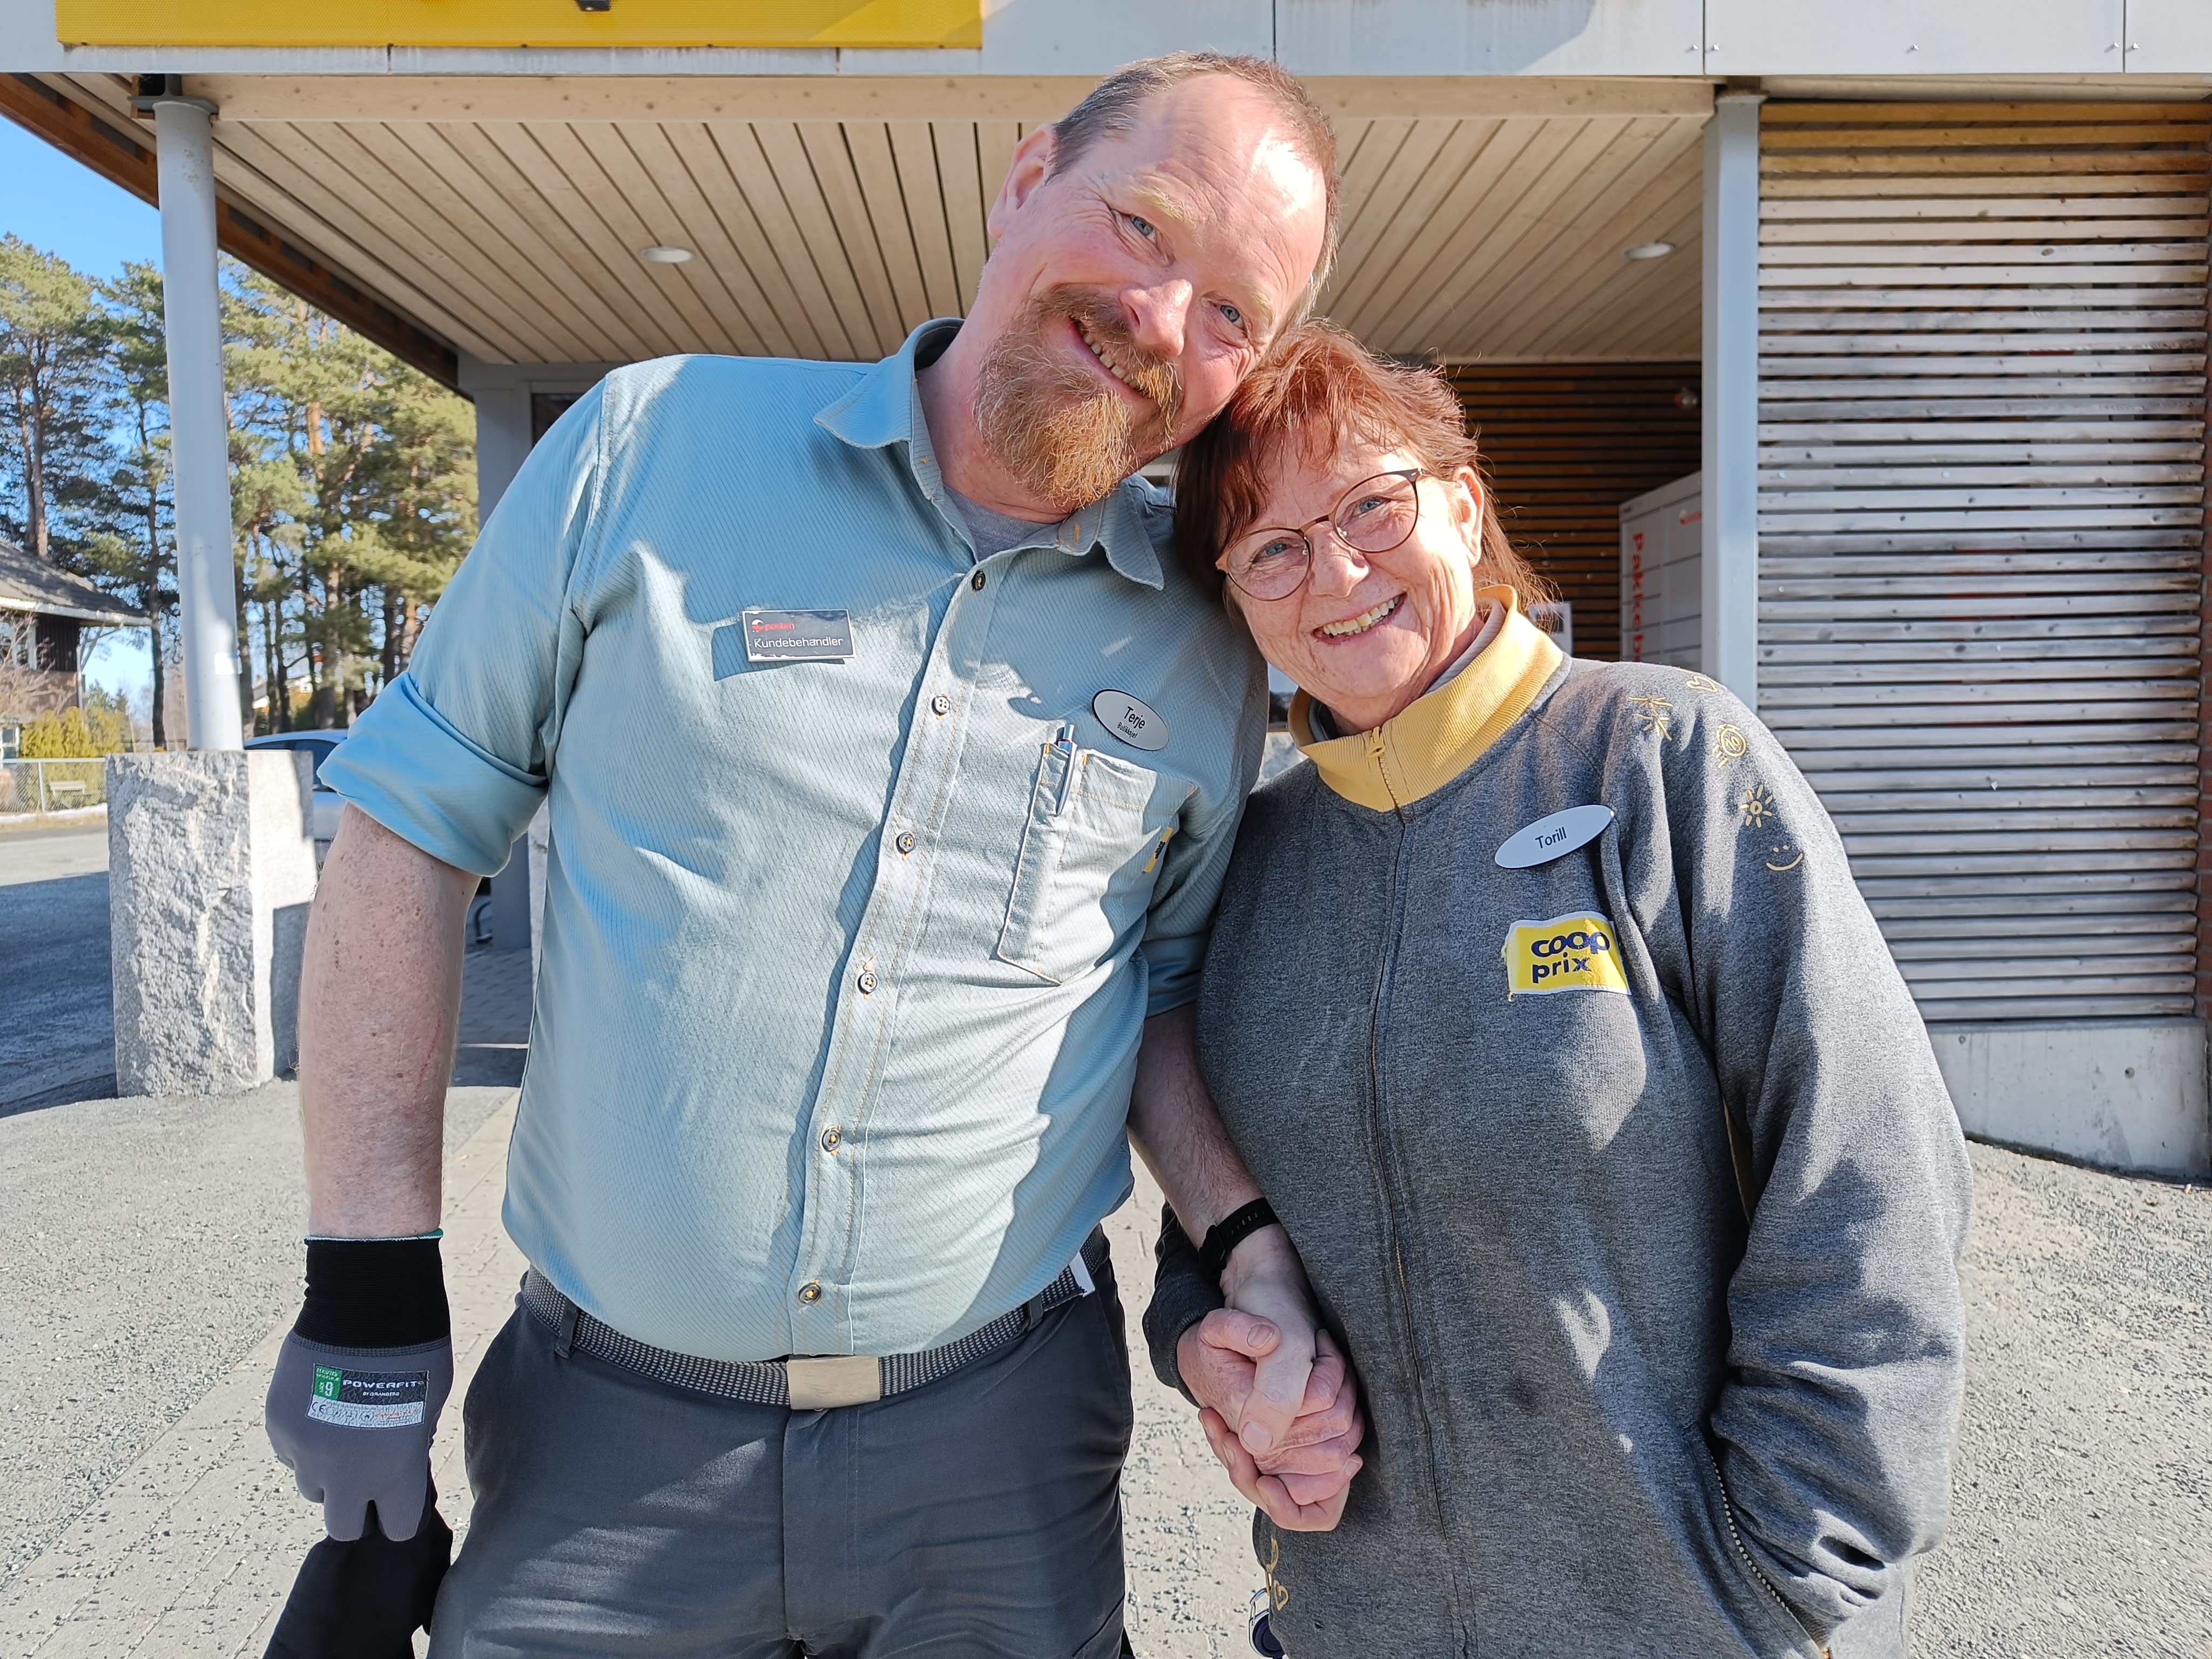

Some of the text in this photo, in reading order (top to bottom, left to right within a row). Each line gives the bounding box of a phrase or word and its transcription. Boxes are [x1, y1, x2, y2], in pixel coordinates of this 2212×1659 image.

[754, 637, 844, 648] Kundebehandler
[1124, 706, 1145, 729] Terje
[1117, 721, 1138, 739] Butikksjef
[1535, 826, 1567, 849] Torill
[1530, 931, 1610, 958] coop
[1532, 952, 1592, 983] prix
[342, 1379, 417, 1388] POWERFIT
